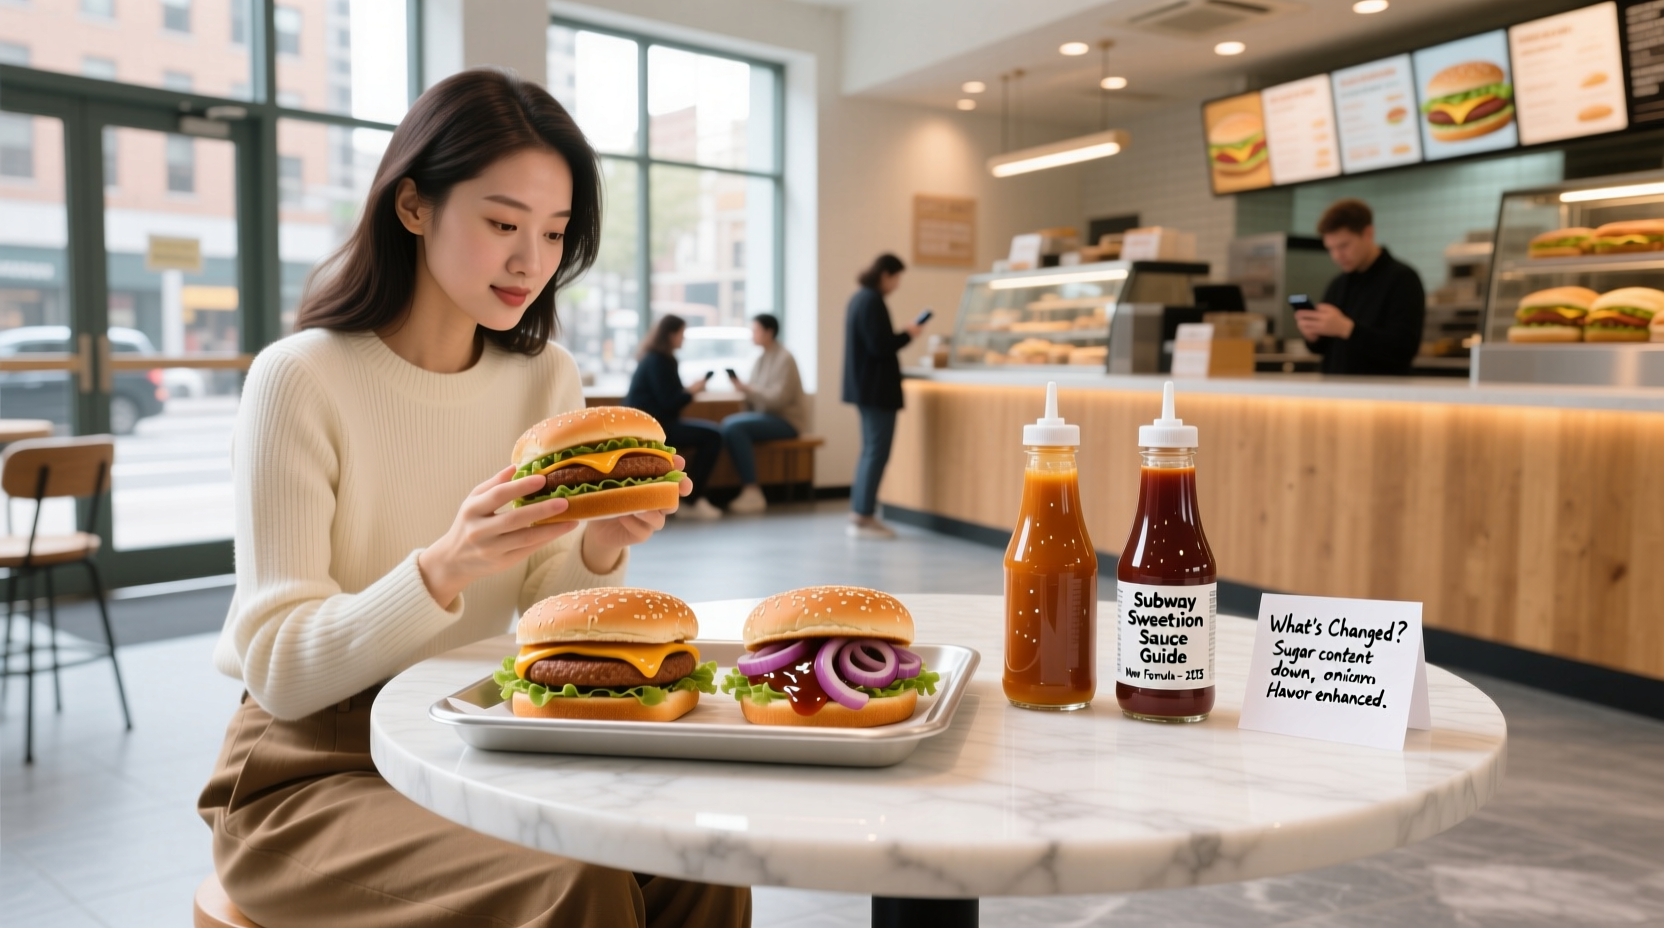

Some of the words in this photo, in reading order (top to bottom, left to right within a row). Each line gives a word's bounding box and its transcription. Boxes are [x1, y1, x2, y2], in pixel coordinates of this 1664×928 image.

[1133, 591, 1197, 612] Subway
[1138, 629, 1189, 646] Sauce
[1270, 612, 1323, 636] What's
[1328, 617, 1408, 649] Changed?
[1139, 647, 1188, 664] Guide
[1272, 639, 1317, 664] Sugar
[1318, 647, 1374, 665] content
[1270, 659, 1316, 684] down,
[1315, 687, 1387, 709] enhanced.
